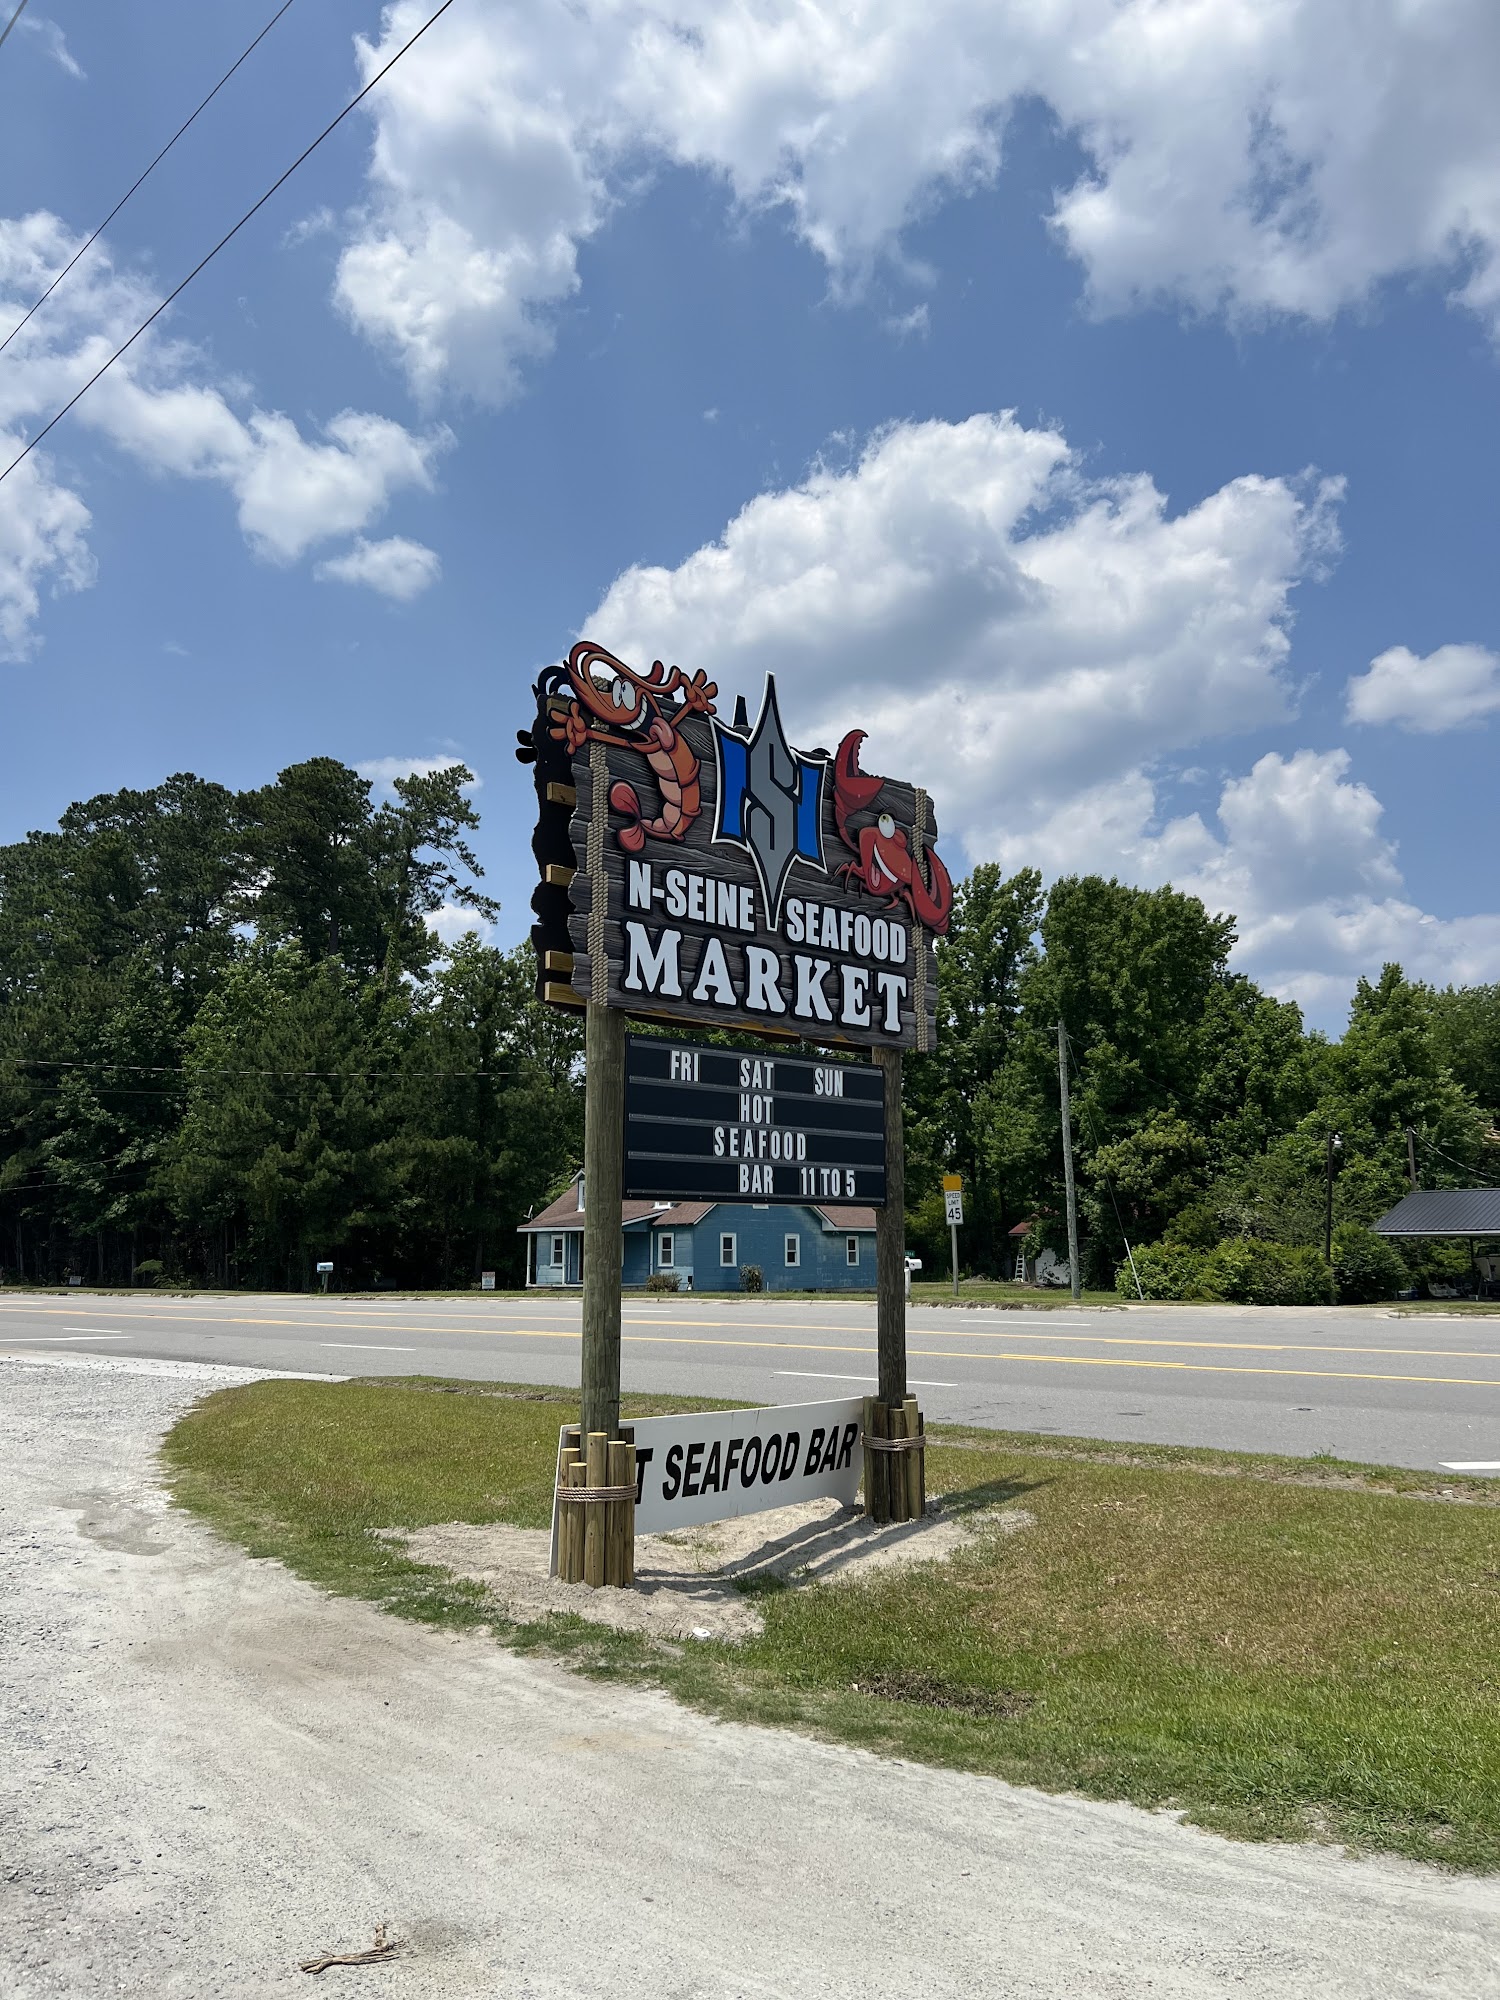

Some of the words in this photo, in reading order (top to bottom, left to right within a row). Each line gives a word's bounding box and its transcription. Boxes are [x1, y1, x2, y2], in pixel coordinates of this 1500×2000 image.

[628, 859, 755, 932] N-SEINE
[786, 898, 907, 965] SEAFOOD
[623, 921, 907, 1032] MARKET
[670, 1050, 699, 1082] FRI
[740, 1057, 774, 1090] SAT
[814, 1067, 844, 1097] SUN
[740, 1093, 773, 1124] HOT
[714, 1126, 806, 1161] SEAFOOD
[739, 1163, 774, 1194] BAR
[948, 1207, 961, 1220] 45
[662, 1431, 799, 1501] SEAFOOD
[804, 1422, 858, 1477] BAR
